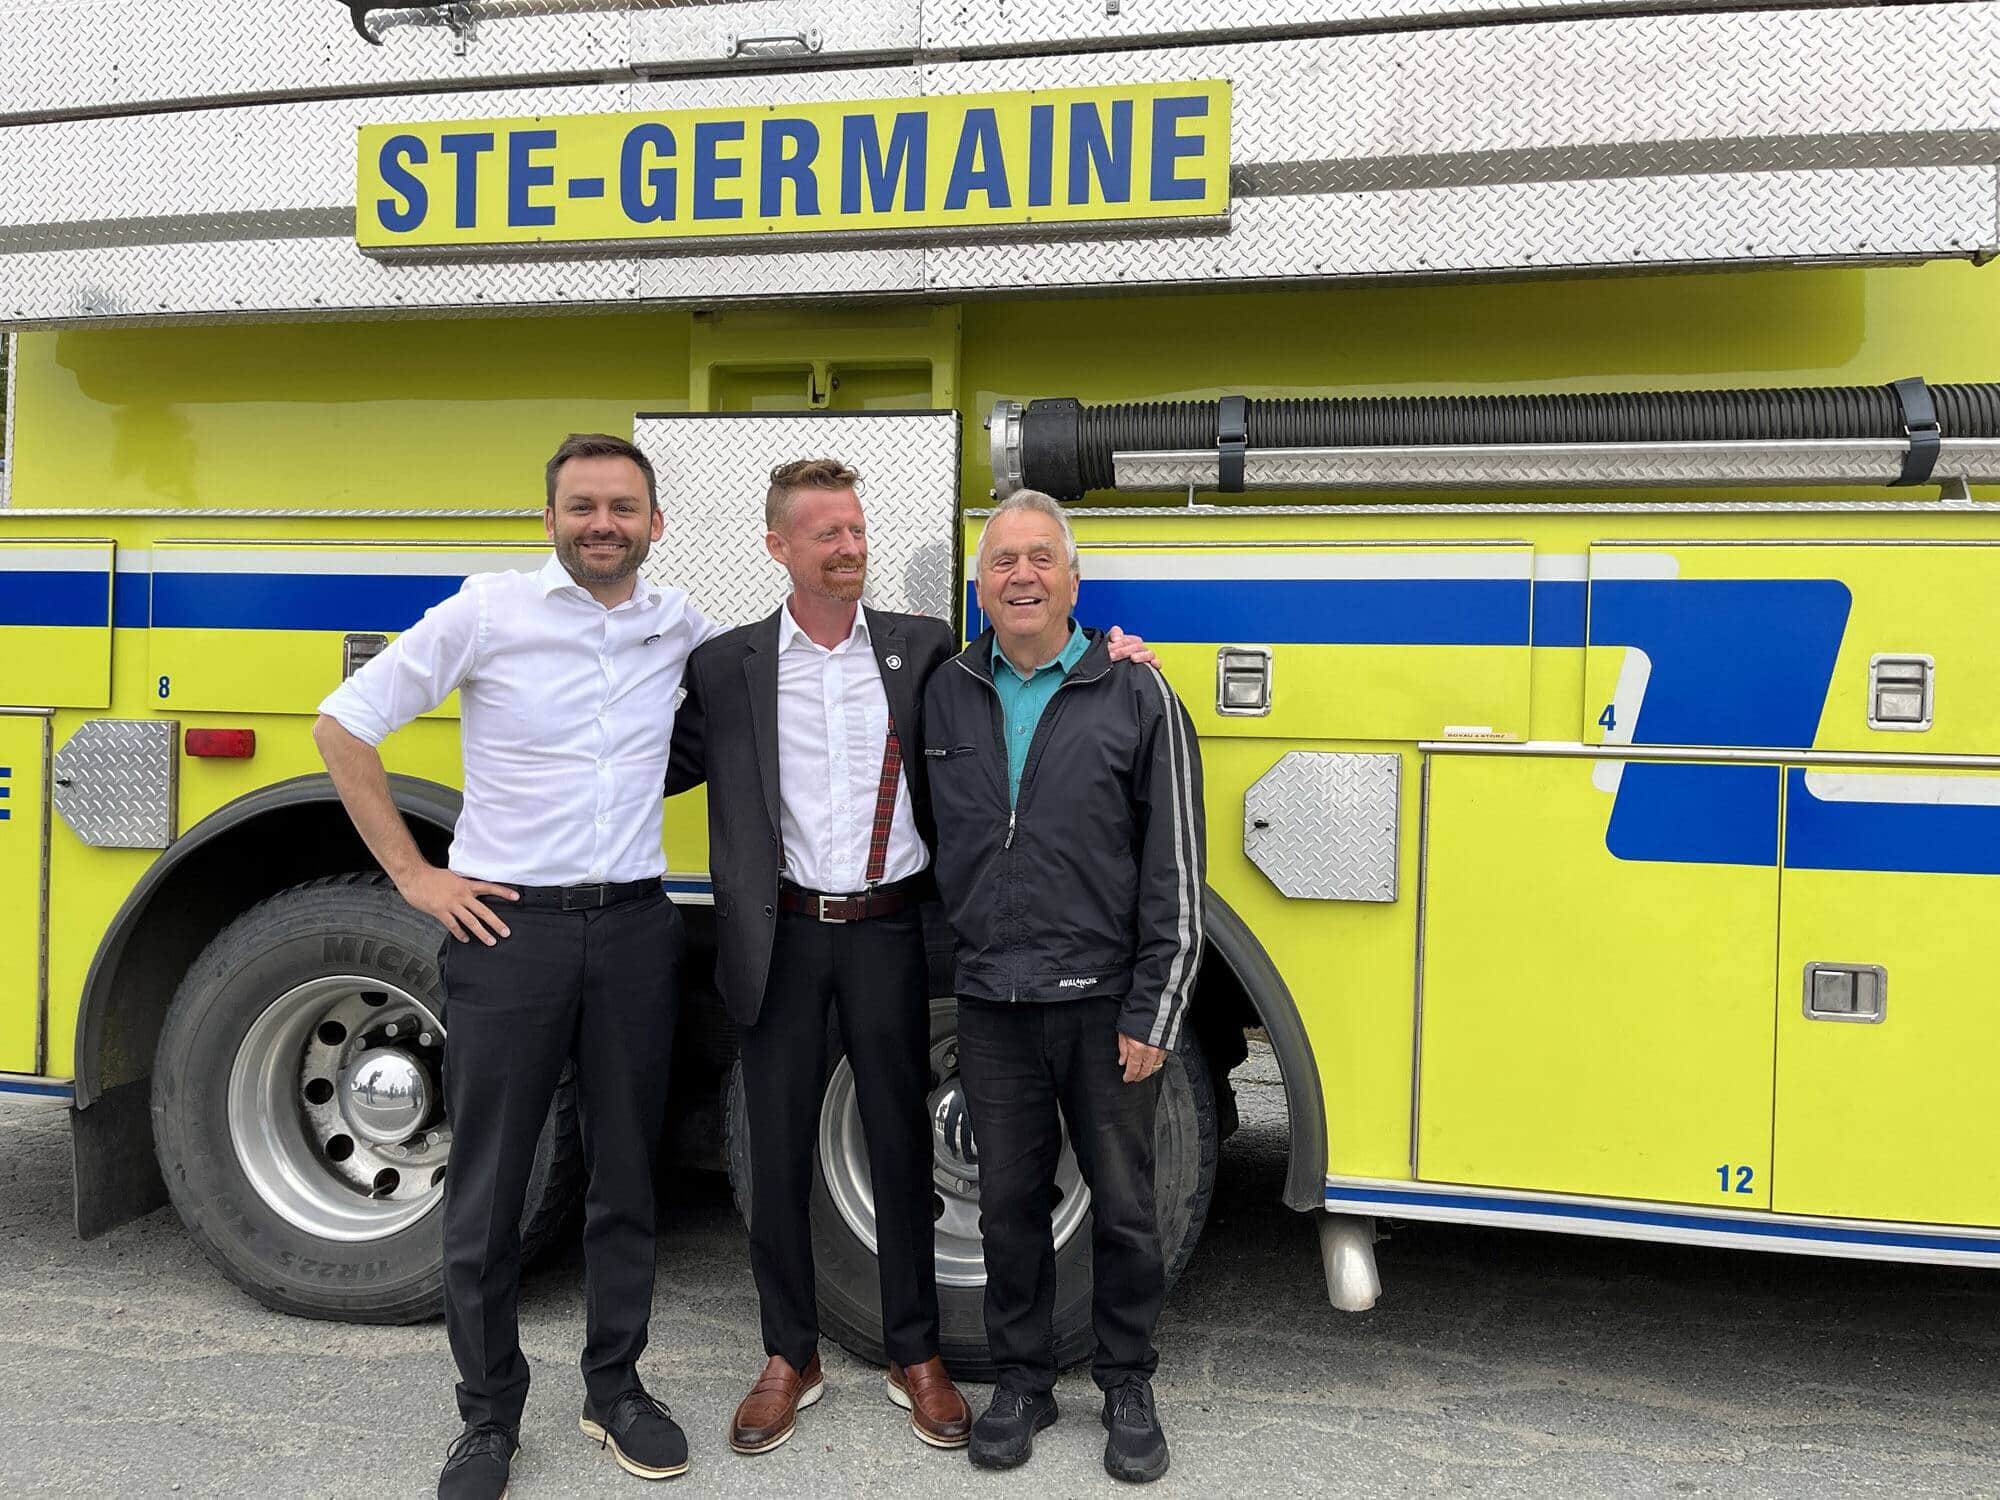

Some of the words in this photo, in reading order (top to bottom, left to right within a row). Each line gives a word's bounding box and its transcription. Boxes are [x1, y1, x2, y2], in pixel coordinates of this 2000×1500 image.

[376, 96, 1207, 232] STE-GERMAINE
[159, 676, 170, 699] 8
[1598, 704, 1616, 731] 4
[1716, 1164, 1753, 1193] 12
